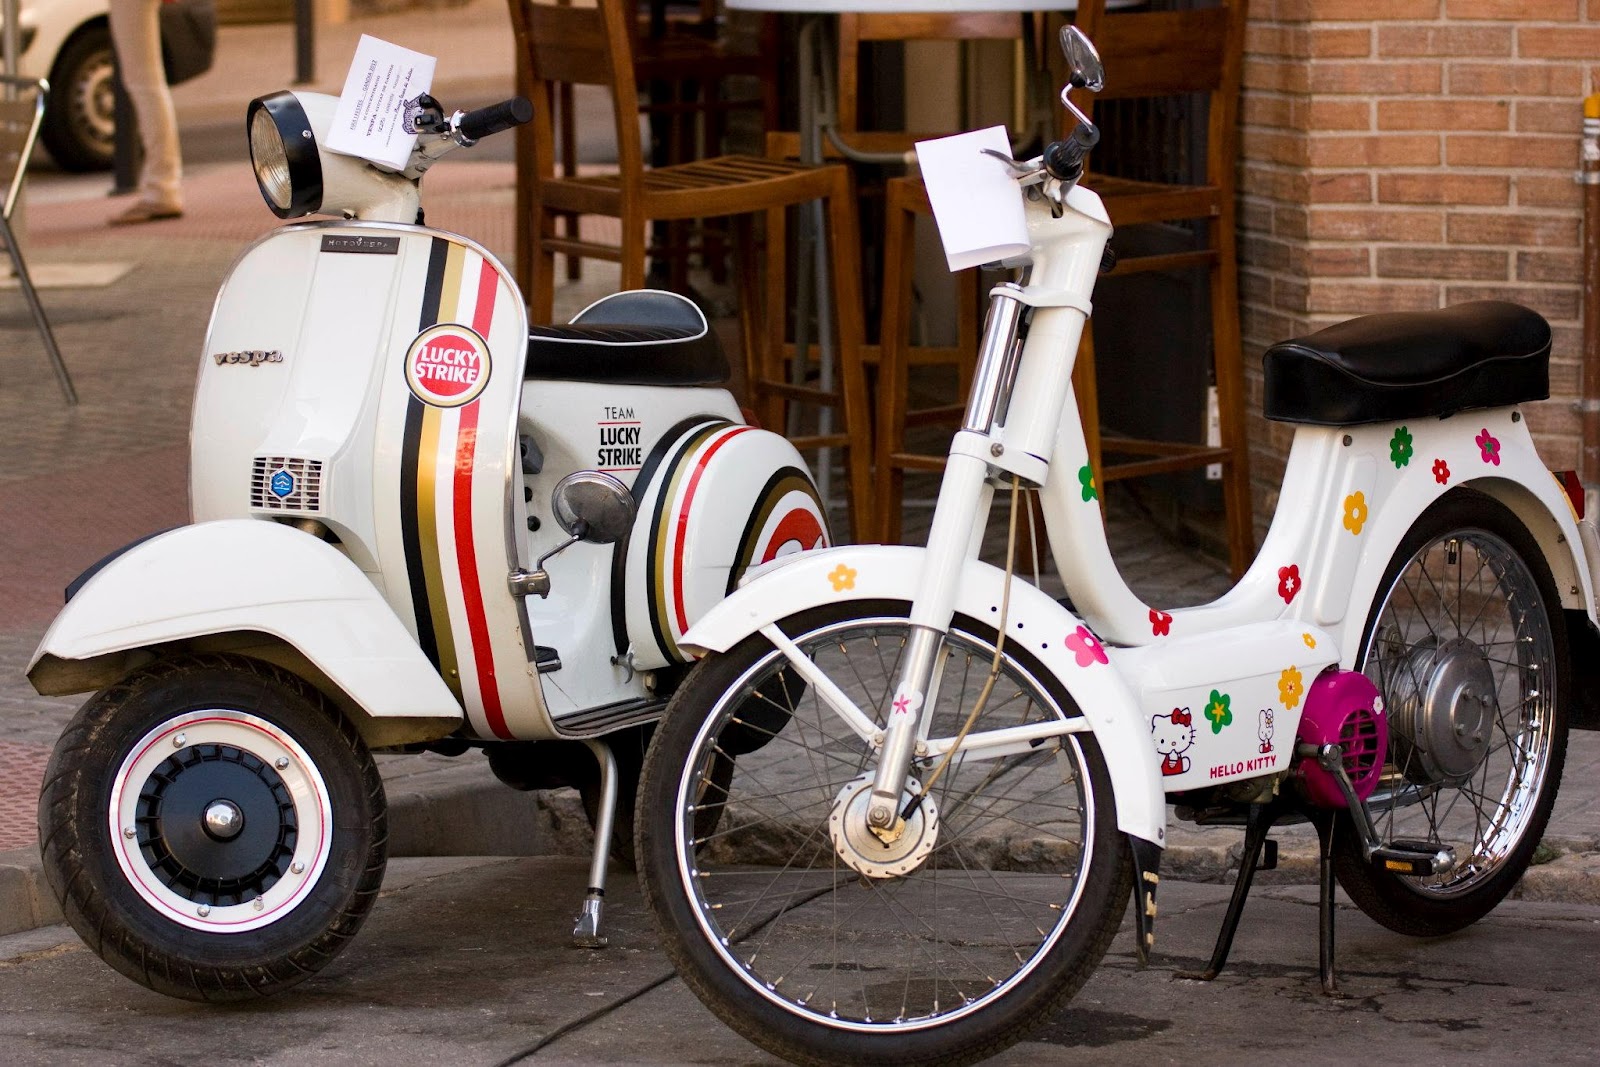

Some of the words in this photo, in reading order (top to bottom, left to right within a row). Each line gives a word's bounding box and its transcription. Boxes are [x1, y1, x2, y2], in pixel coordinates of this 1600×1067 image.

[213, 350, 283, 367] vespa
[420, 345, 478, 368] LUCKY
[416, 362, 478, 385] STRIKE
[604, 406, 635, 420] TEAM
[600, 427, 641, 446] LUCKY
[597, 447, 641, 466] STRIKE
[1210, 761, 1244, 779] HELLO
[1246, 755, 1277, 772] KITTY
